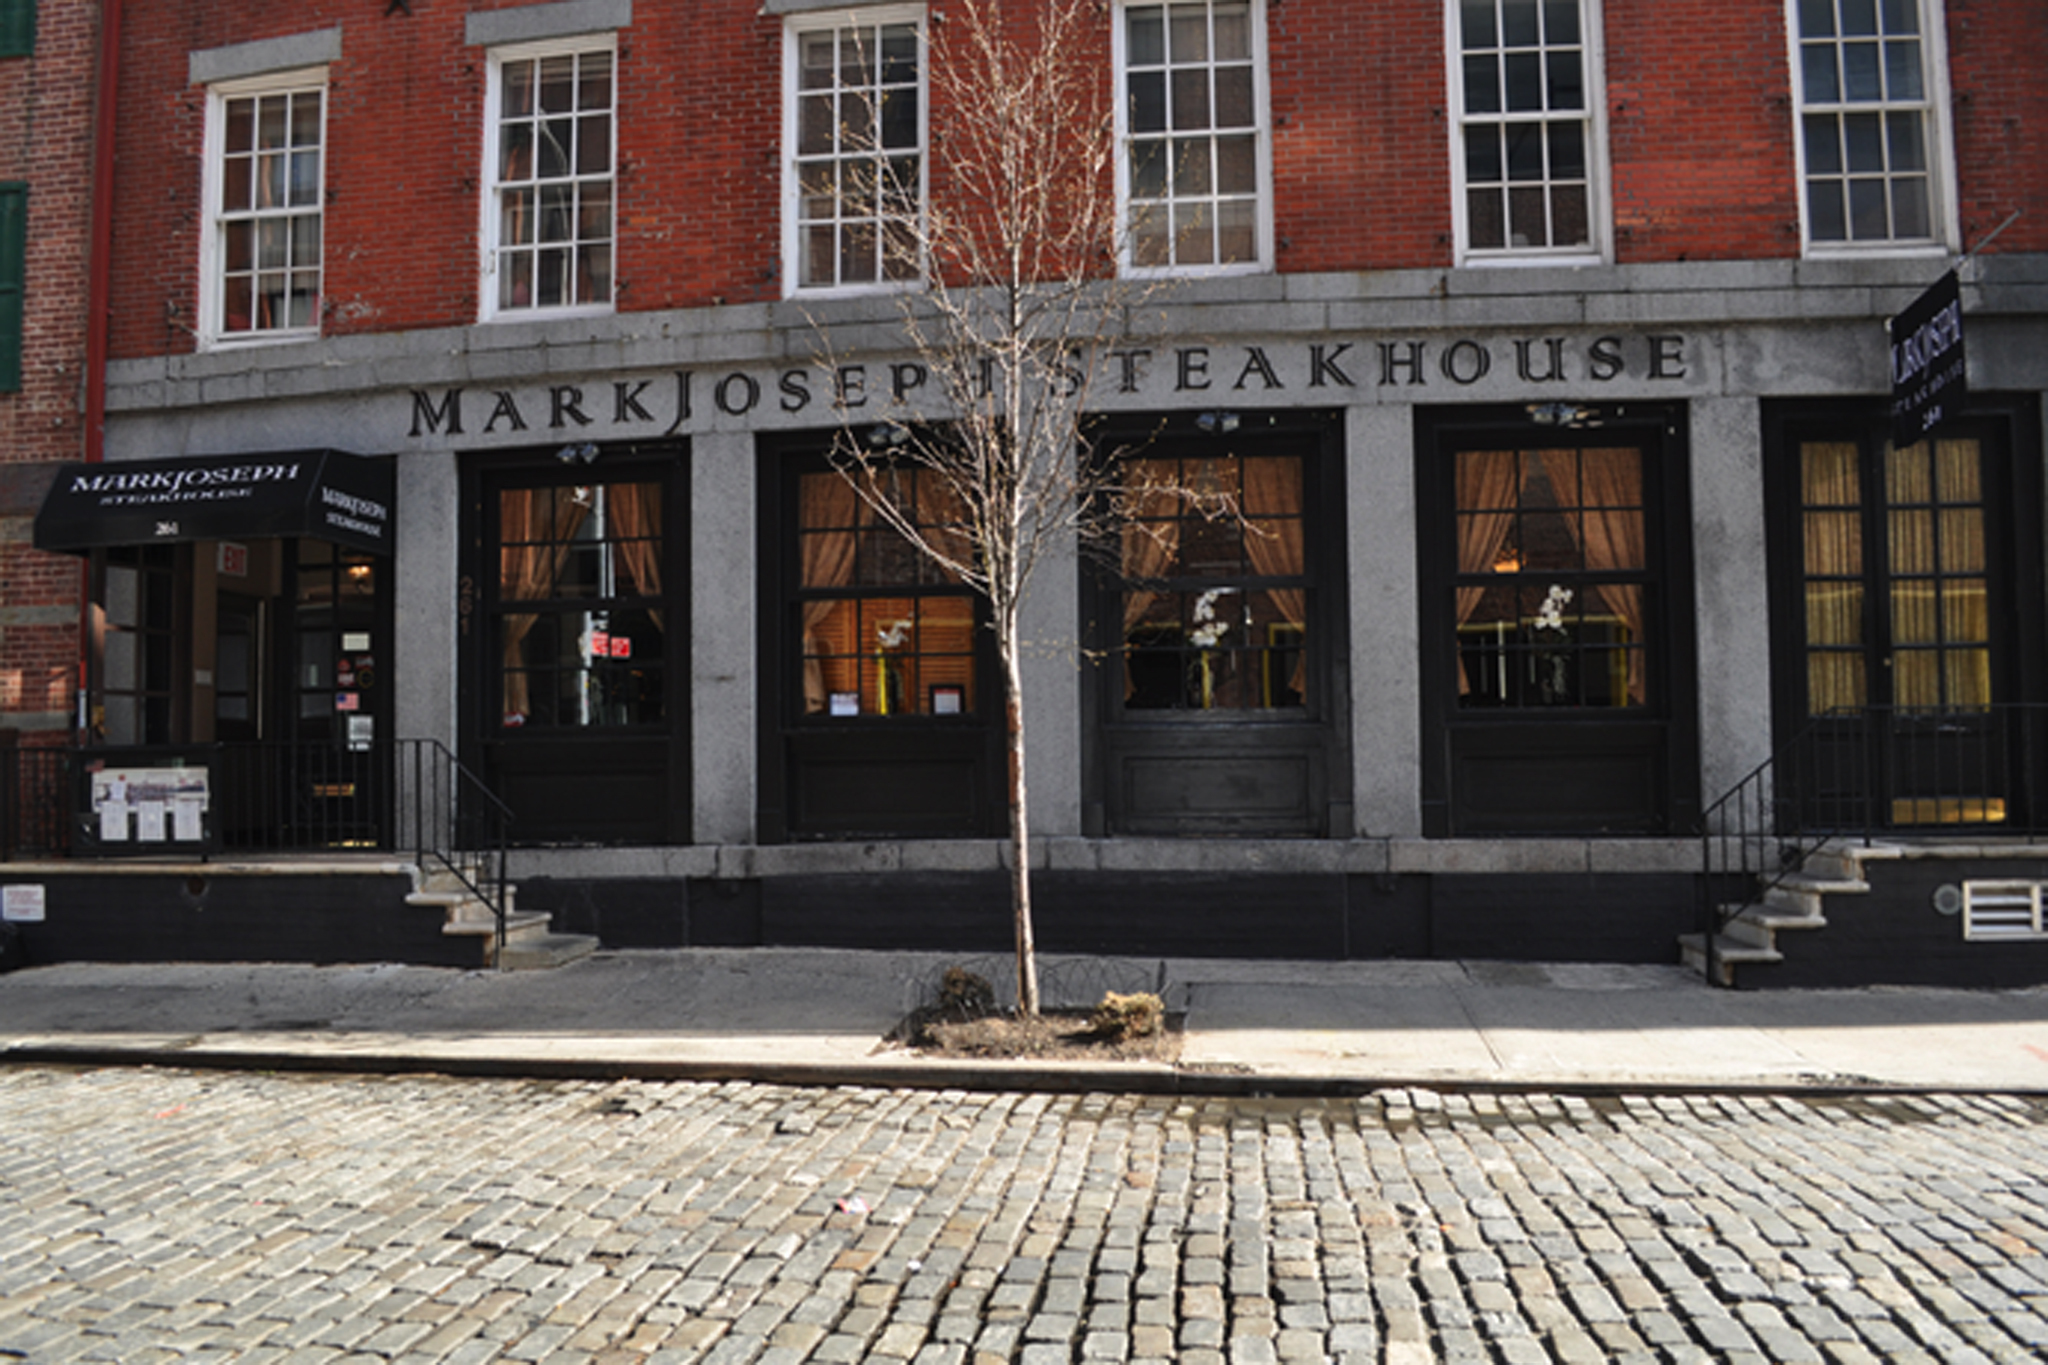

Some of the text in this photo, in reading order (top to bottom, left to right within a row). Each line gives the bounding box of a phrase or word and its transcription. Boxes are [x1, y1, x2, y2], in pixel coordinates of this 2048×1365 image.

[1046, 335, 1689, 398] STEAKHOUSE
[70, 464, 300, 492] MARKJOSEPH
[100, 488, 252, 505] STEAKHOUSE
